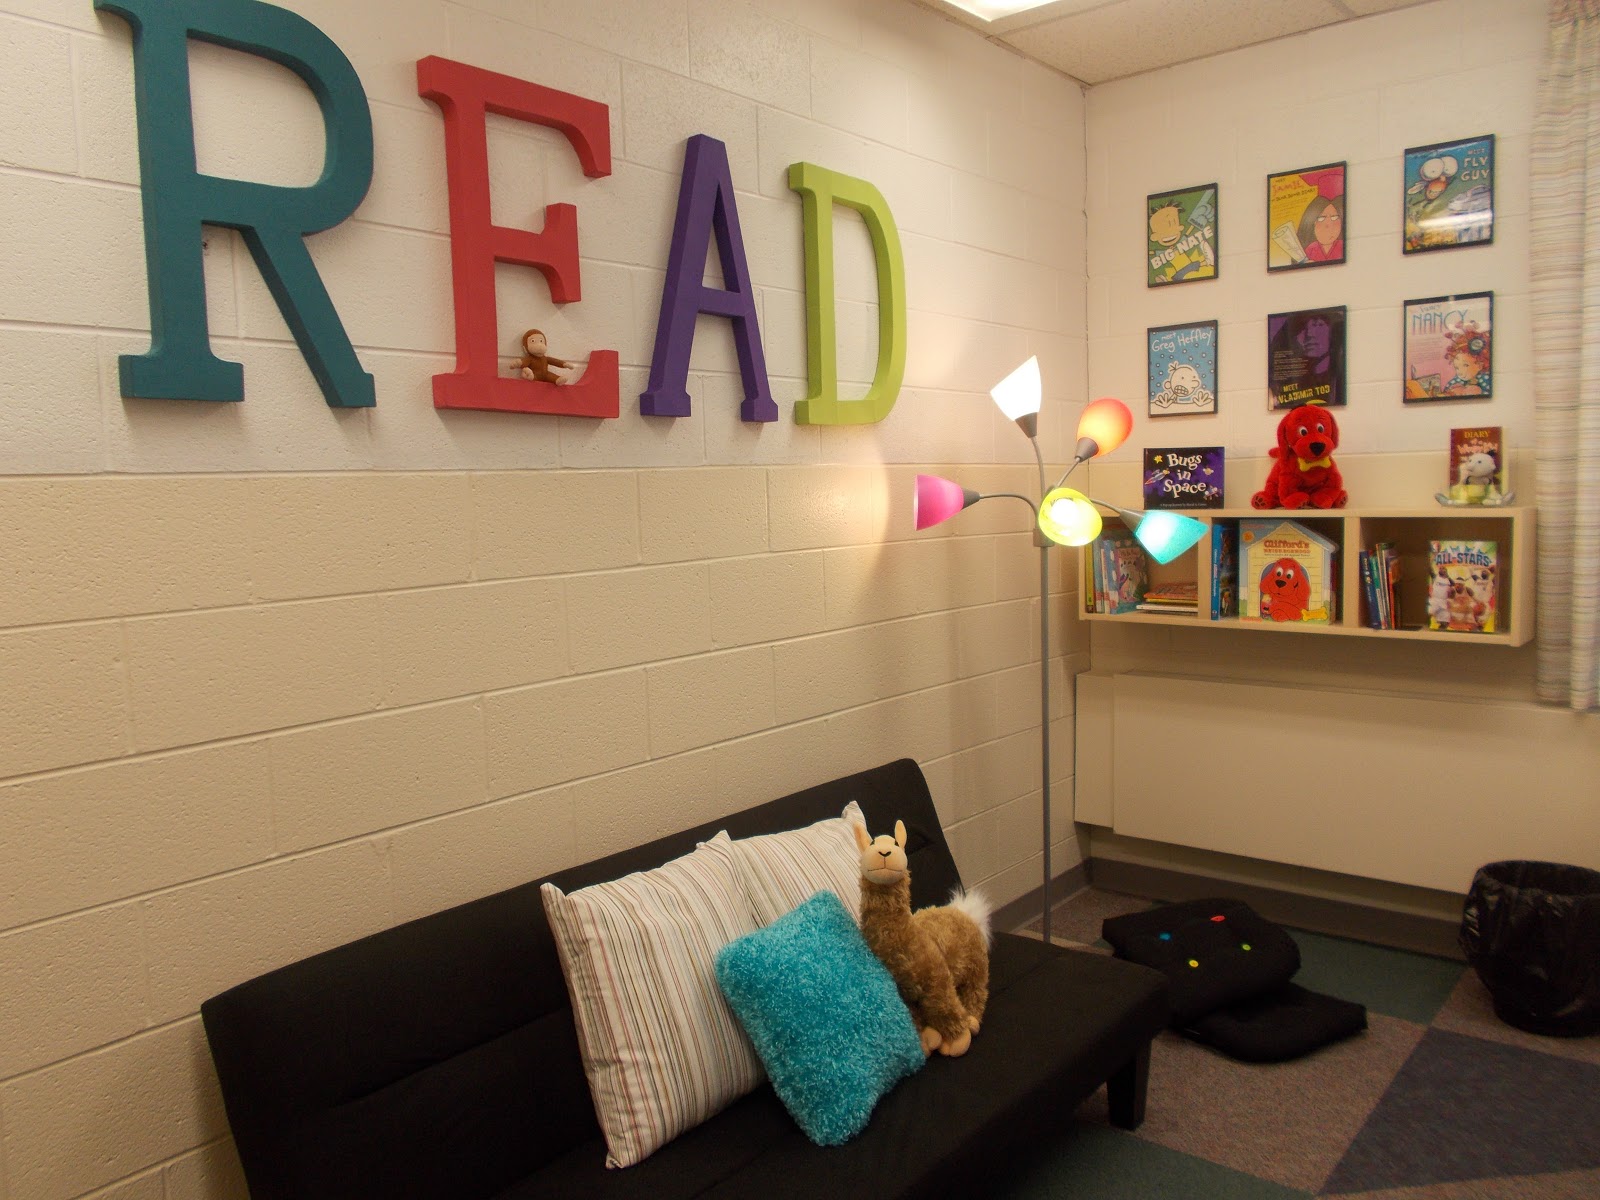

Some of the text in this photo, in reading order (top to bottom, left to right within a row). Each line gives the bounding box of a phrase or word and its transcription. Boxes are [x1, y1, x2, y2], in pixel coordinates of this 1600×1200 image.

[1463, 156, 1488, 168] FLY
[1460, 169, 1489, 181] GUY
[93, 0, 907, 426] READ
[1150, 225, 1214, 270] BIG NATE
[1412, 305, 1470, 336] NANCY
[1151, 328, 1213, 353] Greg Heffley
[1278, 384, 1331, 404] VLADIMIR TOD
[1282, 383, 1299, 393] MEET
[1463, 430, 1490, 439] DIARY
[1166, 452, 1203, 471] Bugs
[1176, 468, 1192, 481] in
[1163, 478, 1207, 499] Space
[1263, 539, 1310, 549] Clifford's
[1435, 552, 1490, 567] ALL-STARS
